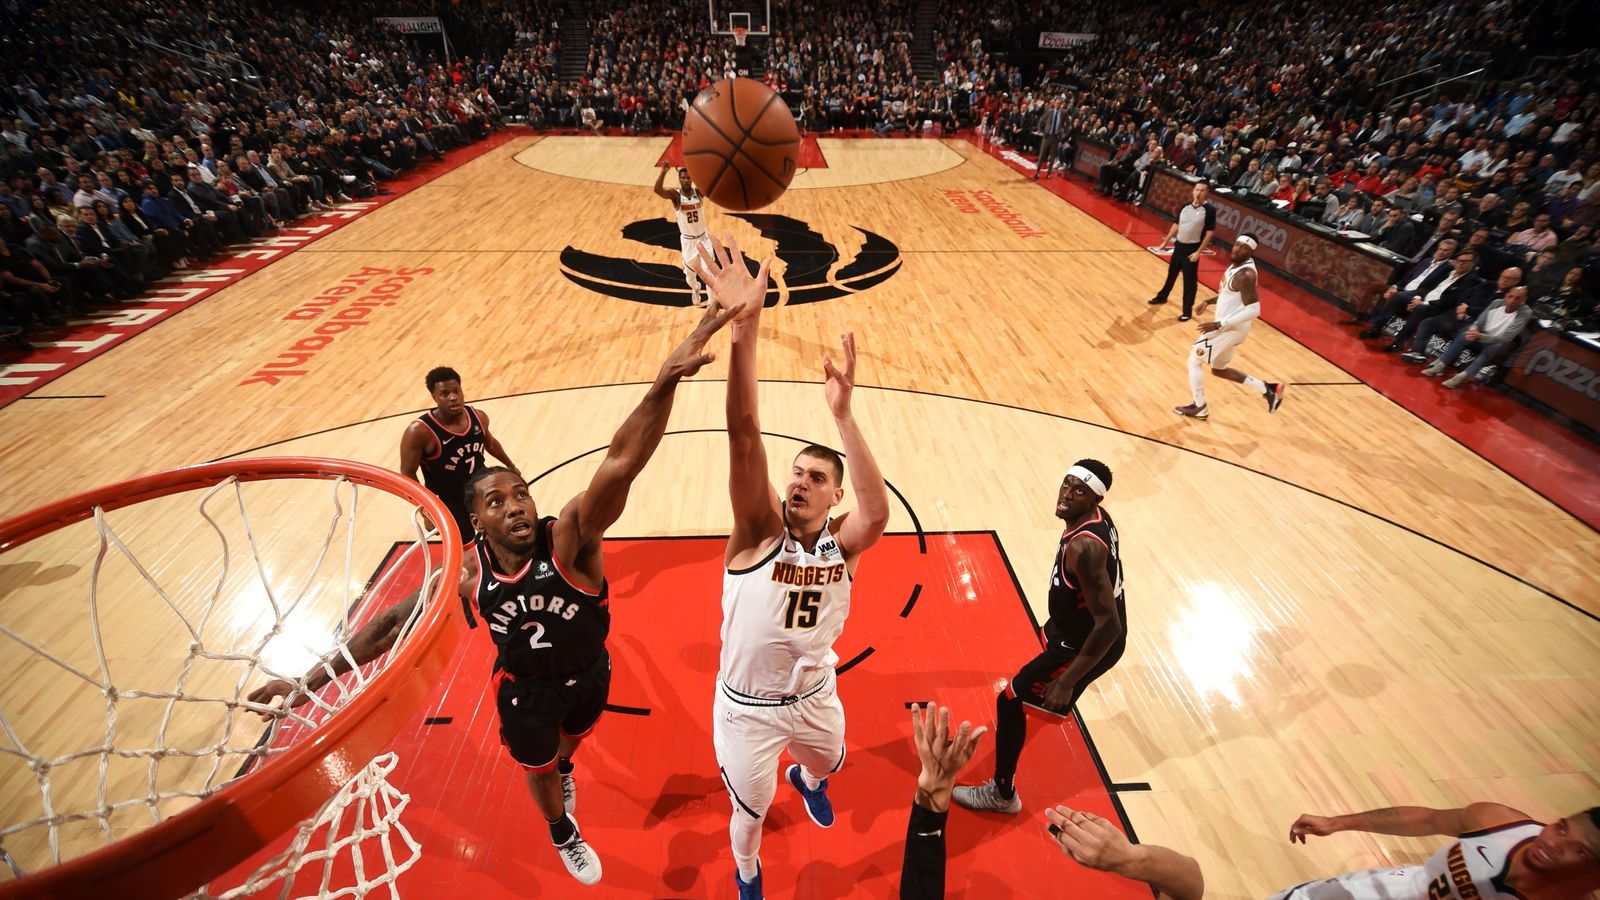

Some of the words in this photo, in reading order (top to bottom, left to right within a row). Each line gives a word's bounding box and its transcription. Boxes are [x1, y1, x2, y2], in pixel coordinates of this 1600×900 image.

[412, 22, 438, 32] LIGHT
[686, 210, 699, 224] 25
[970, 189, 1048, 239] Scotiabank
[281, 266, 393, 321] Arena
[237, 267, 435, 388] Scotiabank
[444, 442, 484, 471] RAPTO
[465, 456, 475, 474] 7
[771, 561, 845, 587] NUGGETS
[489, 594, 580, 635] RAPTORS
[784, 590, 822, 630] 15
[520, 621, 553, 649] 2
[1446, 842, 1482, 900] NUGG
